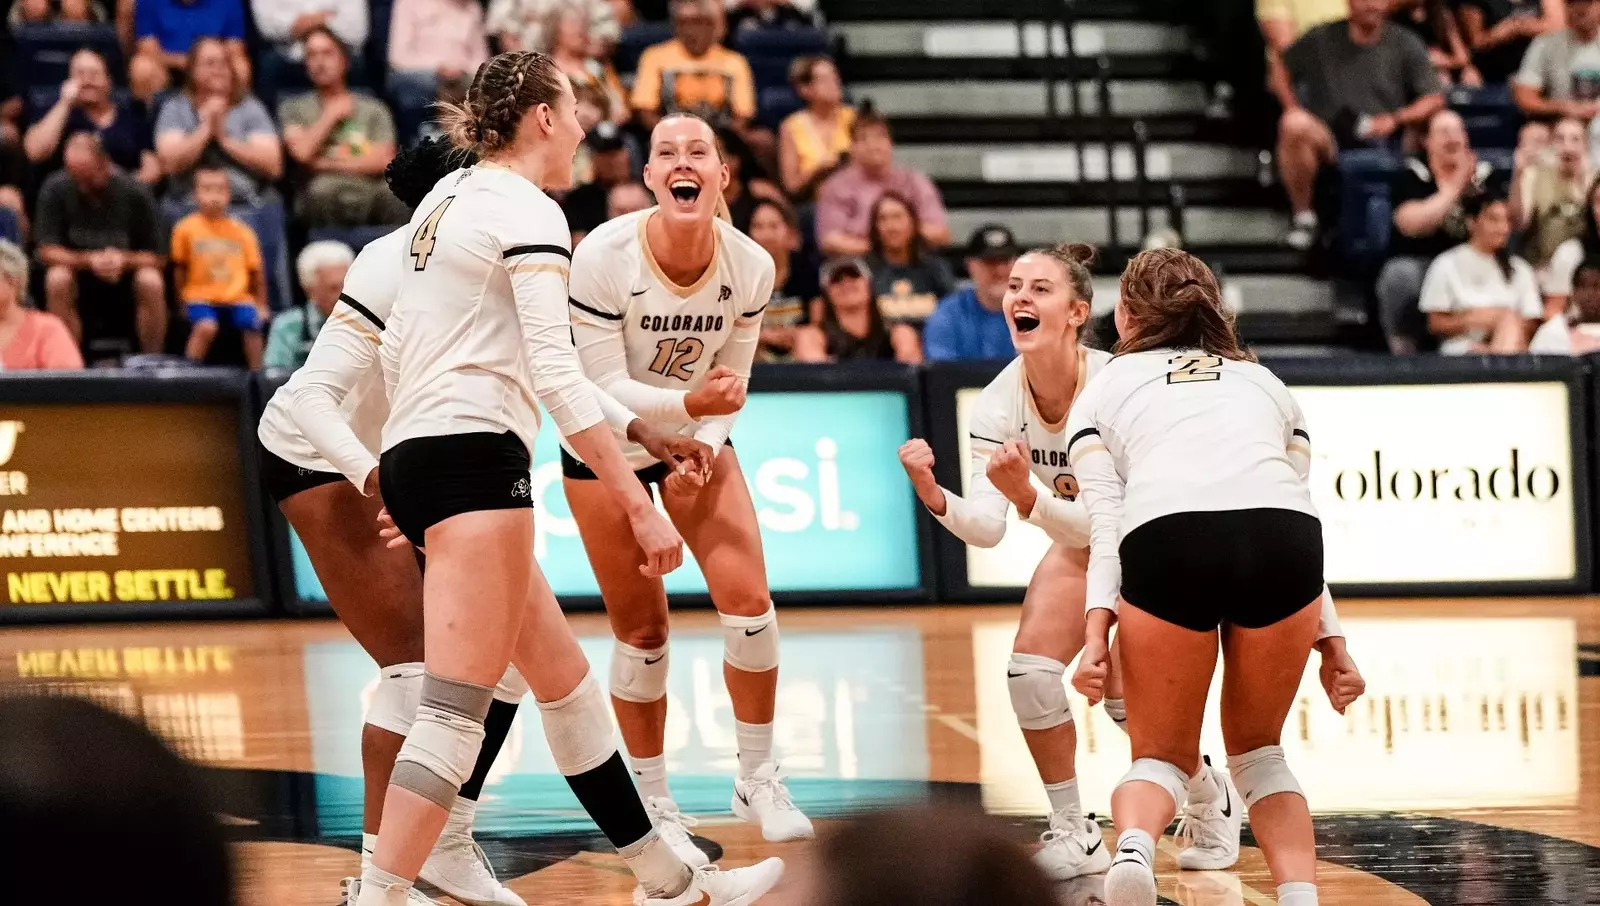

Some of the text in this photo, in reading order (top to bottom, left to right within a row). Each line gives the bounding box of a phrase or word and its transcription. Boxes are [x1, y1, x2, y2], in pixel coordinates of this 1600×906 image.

[410, 194, 457, 272] 4
[640, 315, 724, 332] COLORADO
[648, 336, 705, 382] 12
[1166, 353, 1224, 385] 2
[1031, 448, 1072, 468] OLOR
[1334, 447, 1560, 501] olorado
[2, 506, 224, 534] AND HOME CENTERS
[7, 568, 236, 604] NEVER SETTLE.
